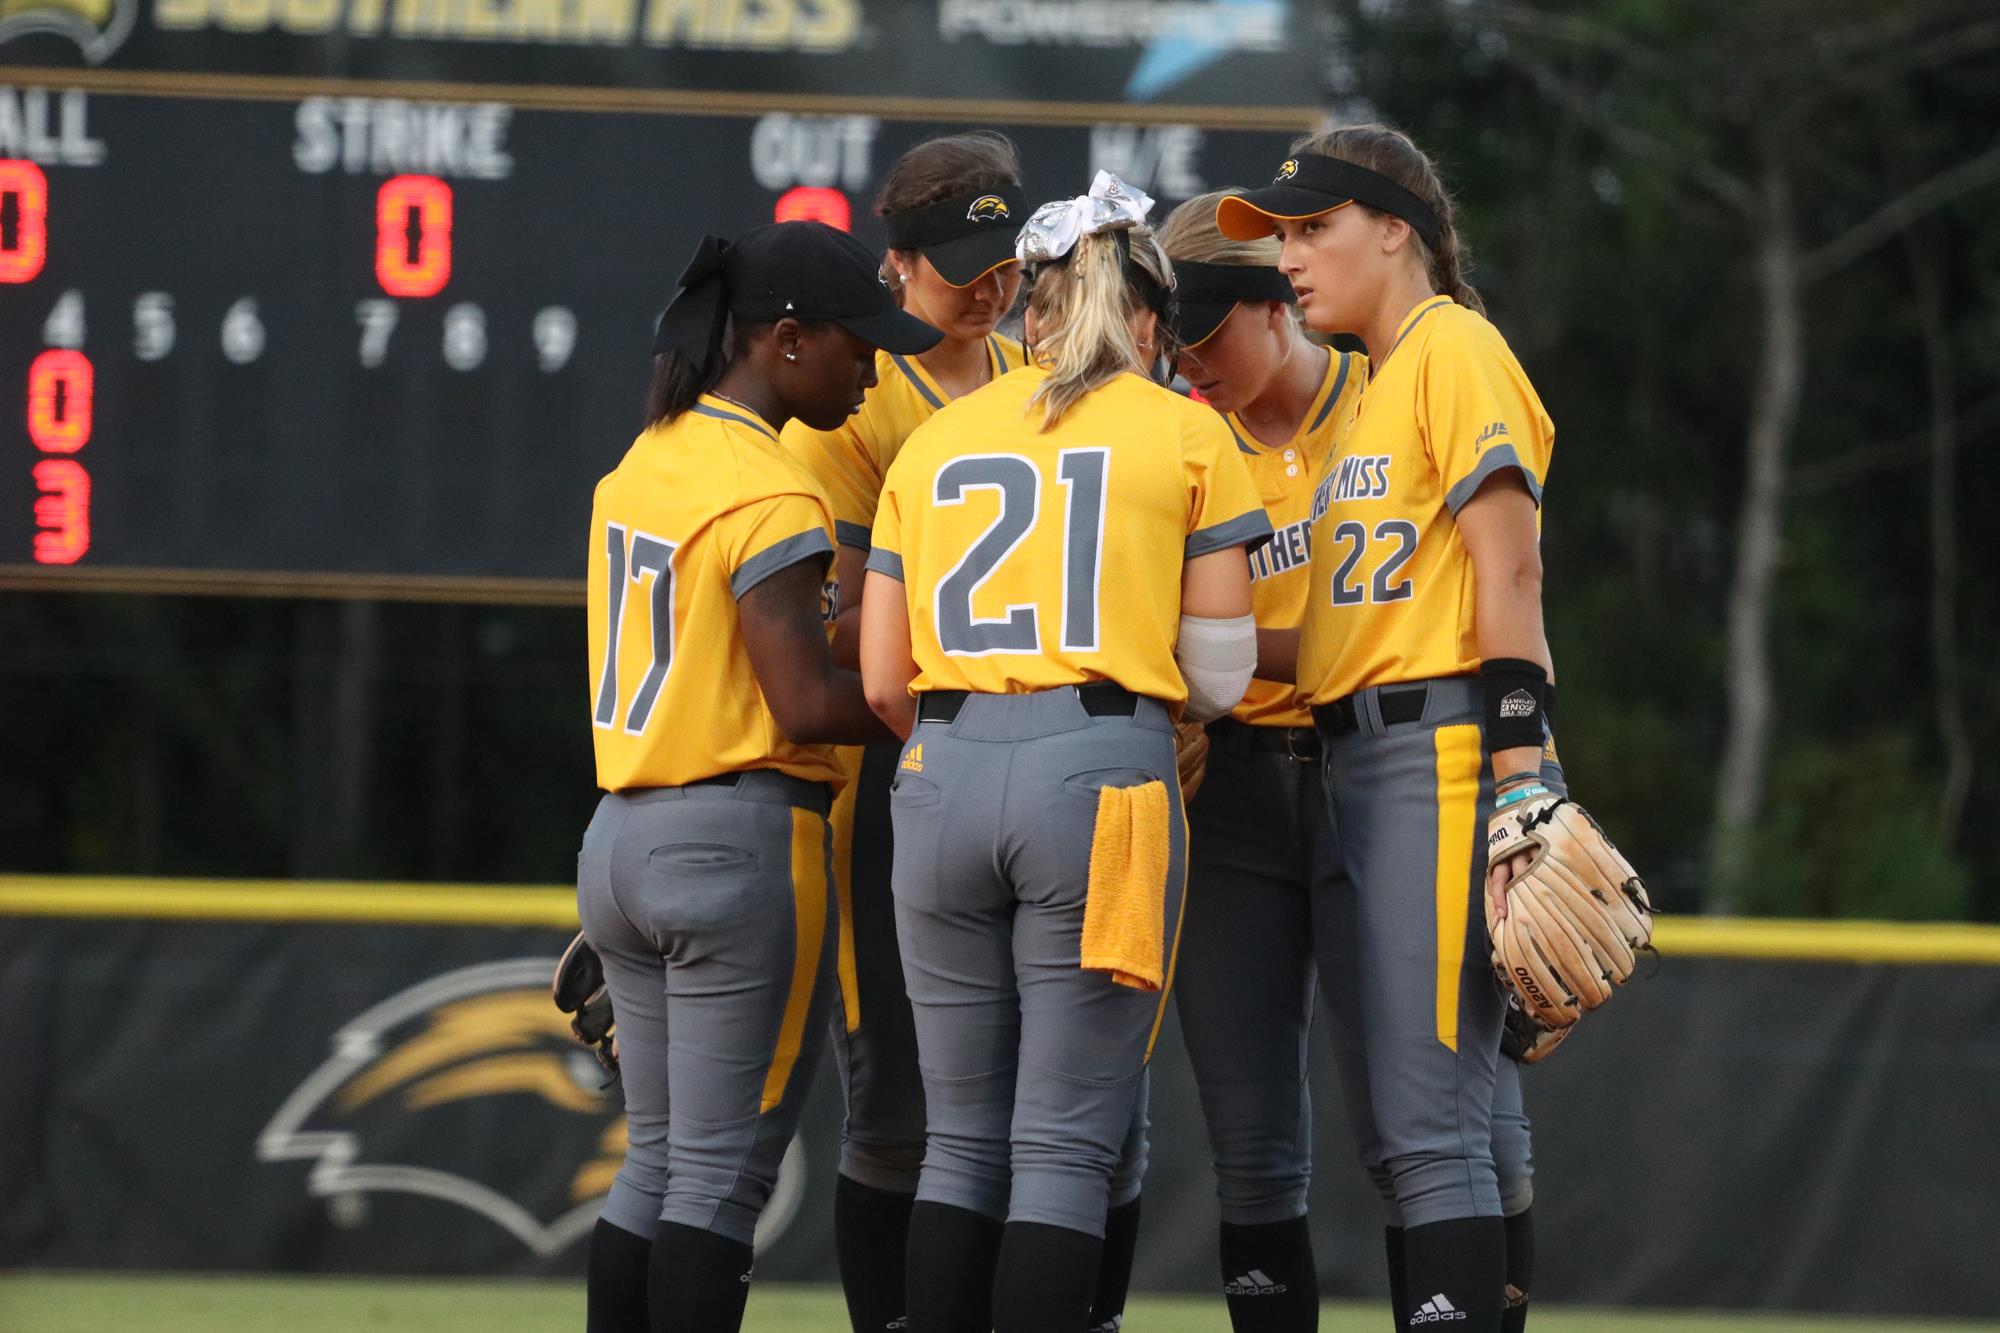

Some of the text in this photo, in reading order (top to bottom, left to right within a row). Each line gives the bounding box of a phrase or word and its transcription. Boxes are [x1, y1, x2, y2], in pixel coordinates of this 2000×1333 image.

[293, 98, 514, 178] STRIKE
[750, 113, 876, 191] OUT
[375, 174, 453, 298] 0
[43, 289, 578, 372] 4 5 6 7 8 9
[28, 349, 93, 453] 0
[33, 459, 91, 565] 3
[1332, 453, 1392, 502] MISS
[932, 446, 1111, 656] 21
[1331, 520, 1420, 607] 22
[593, 519, 679, 736] 17
[1515, 967, 1553, 1008] A2000
[1225, 1284, 1287, 1296] adidas
[1410, 1309, 1467, 1326] adidas
